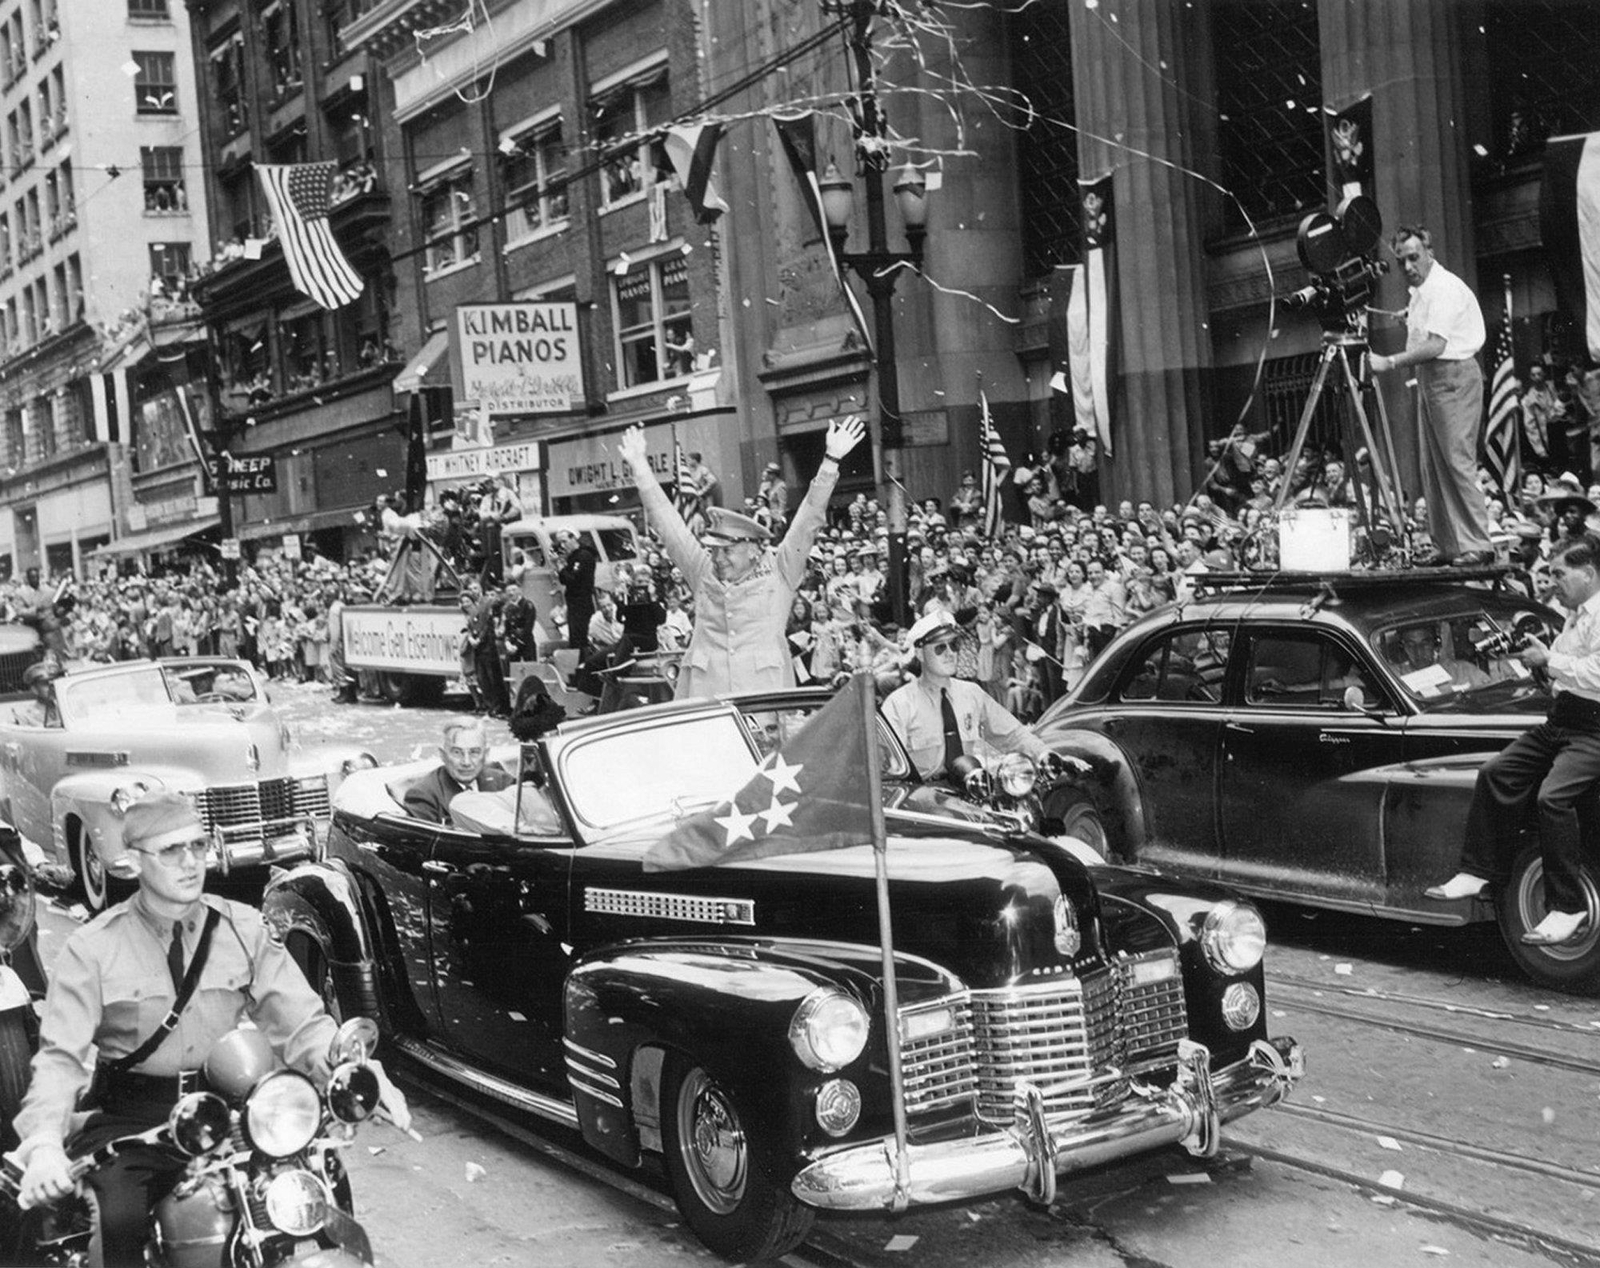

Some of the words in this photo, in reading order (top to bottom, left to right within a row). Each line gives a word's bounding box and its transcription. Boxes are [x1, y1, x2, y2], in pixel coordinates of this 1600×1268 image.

[463, 308, 573, 335] KIMBALL
[472, 338, 567, 365] PIANOS
[488, 398, 564, 411] DISTRIBUTOR
[485, 446, 530, 470] AIRCRAFT
[568, 462, 607, 486] DWIGHT
